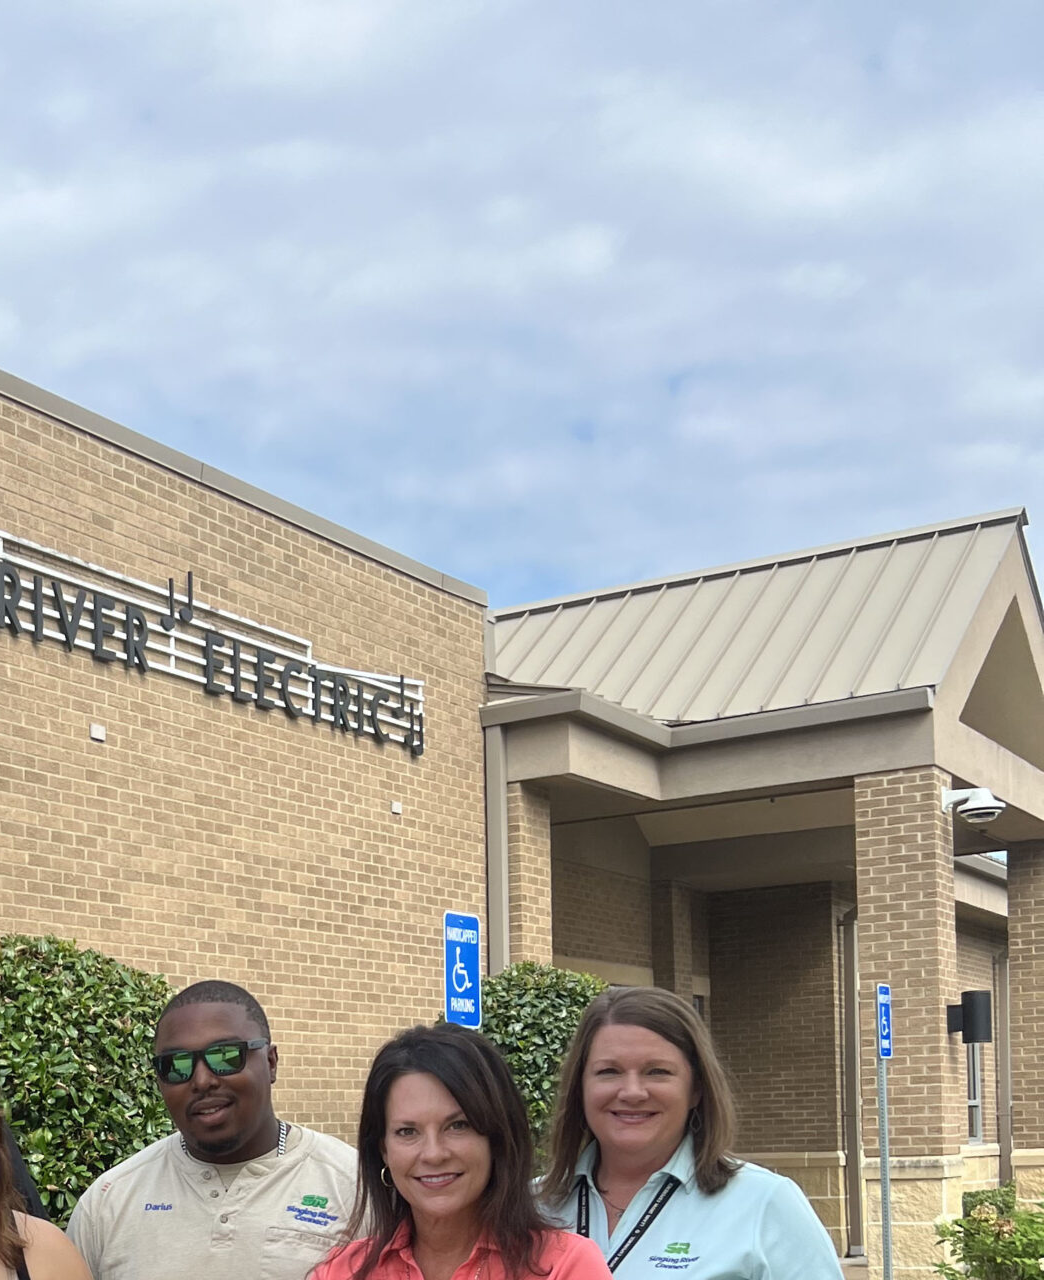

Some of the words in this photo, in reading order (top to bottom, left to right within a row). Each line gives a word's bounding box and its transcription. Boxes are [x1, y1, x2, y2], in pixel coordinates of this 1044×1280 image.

[205, 631, 390, 742] ELECTRIC
[446, 926, 477, 944] HANDICAPPED
[451, 997, 475, 1013] PARKING
[144, 1202, 173, 1212] Darius
[648, 1256, 680, 1264] Singing
